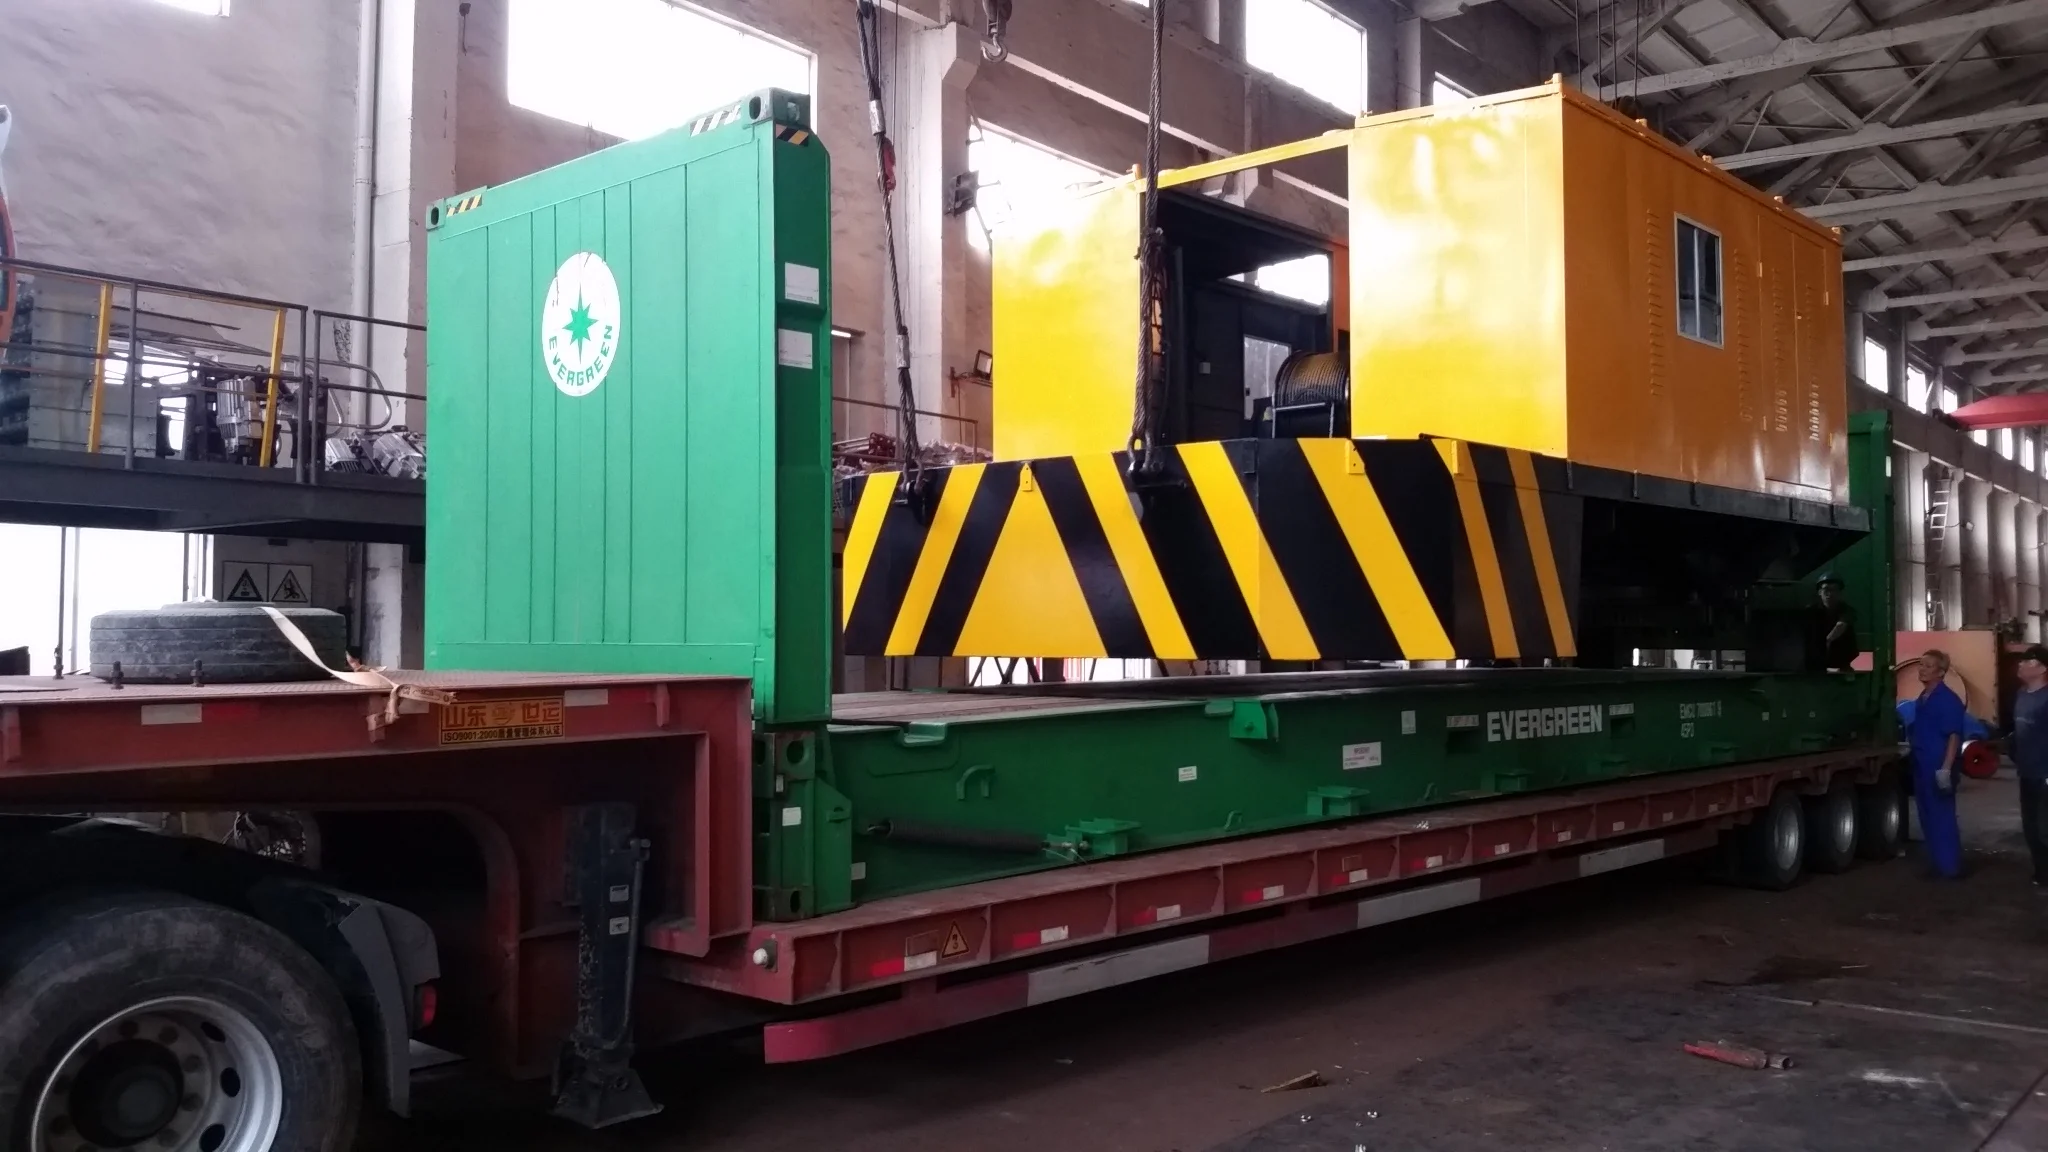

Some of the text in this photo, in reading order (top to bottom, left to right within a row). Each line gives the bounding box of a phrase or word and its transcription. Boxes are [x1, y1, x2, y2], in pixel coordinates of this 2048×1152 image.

[549, 325, 613, 386] EVERGREEN
[445, 705, 487, 728] 山东
[1487, 704, 1602, 742] EVERGREEN
